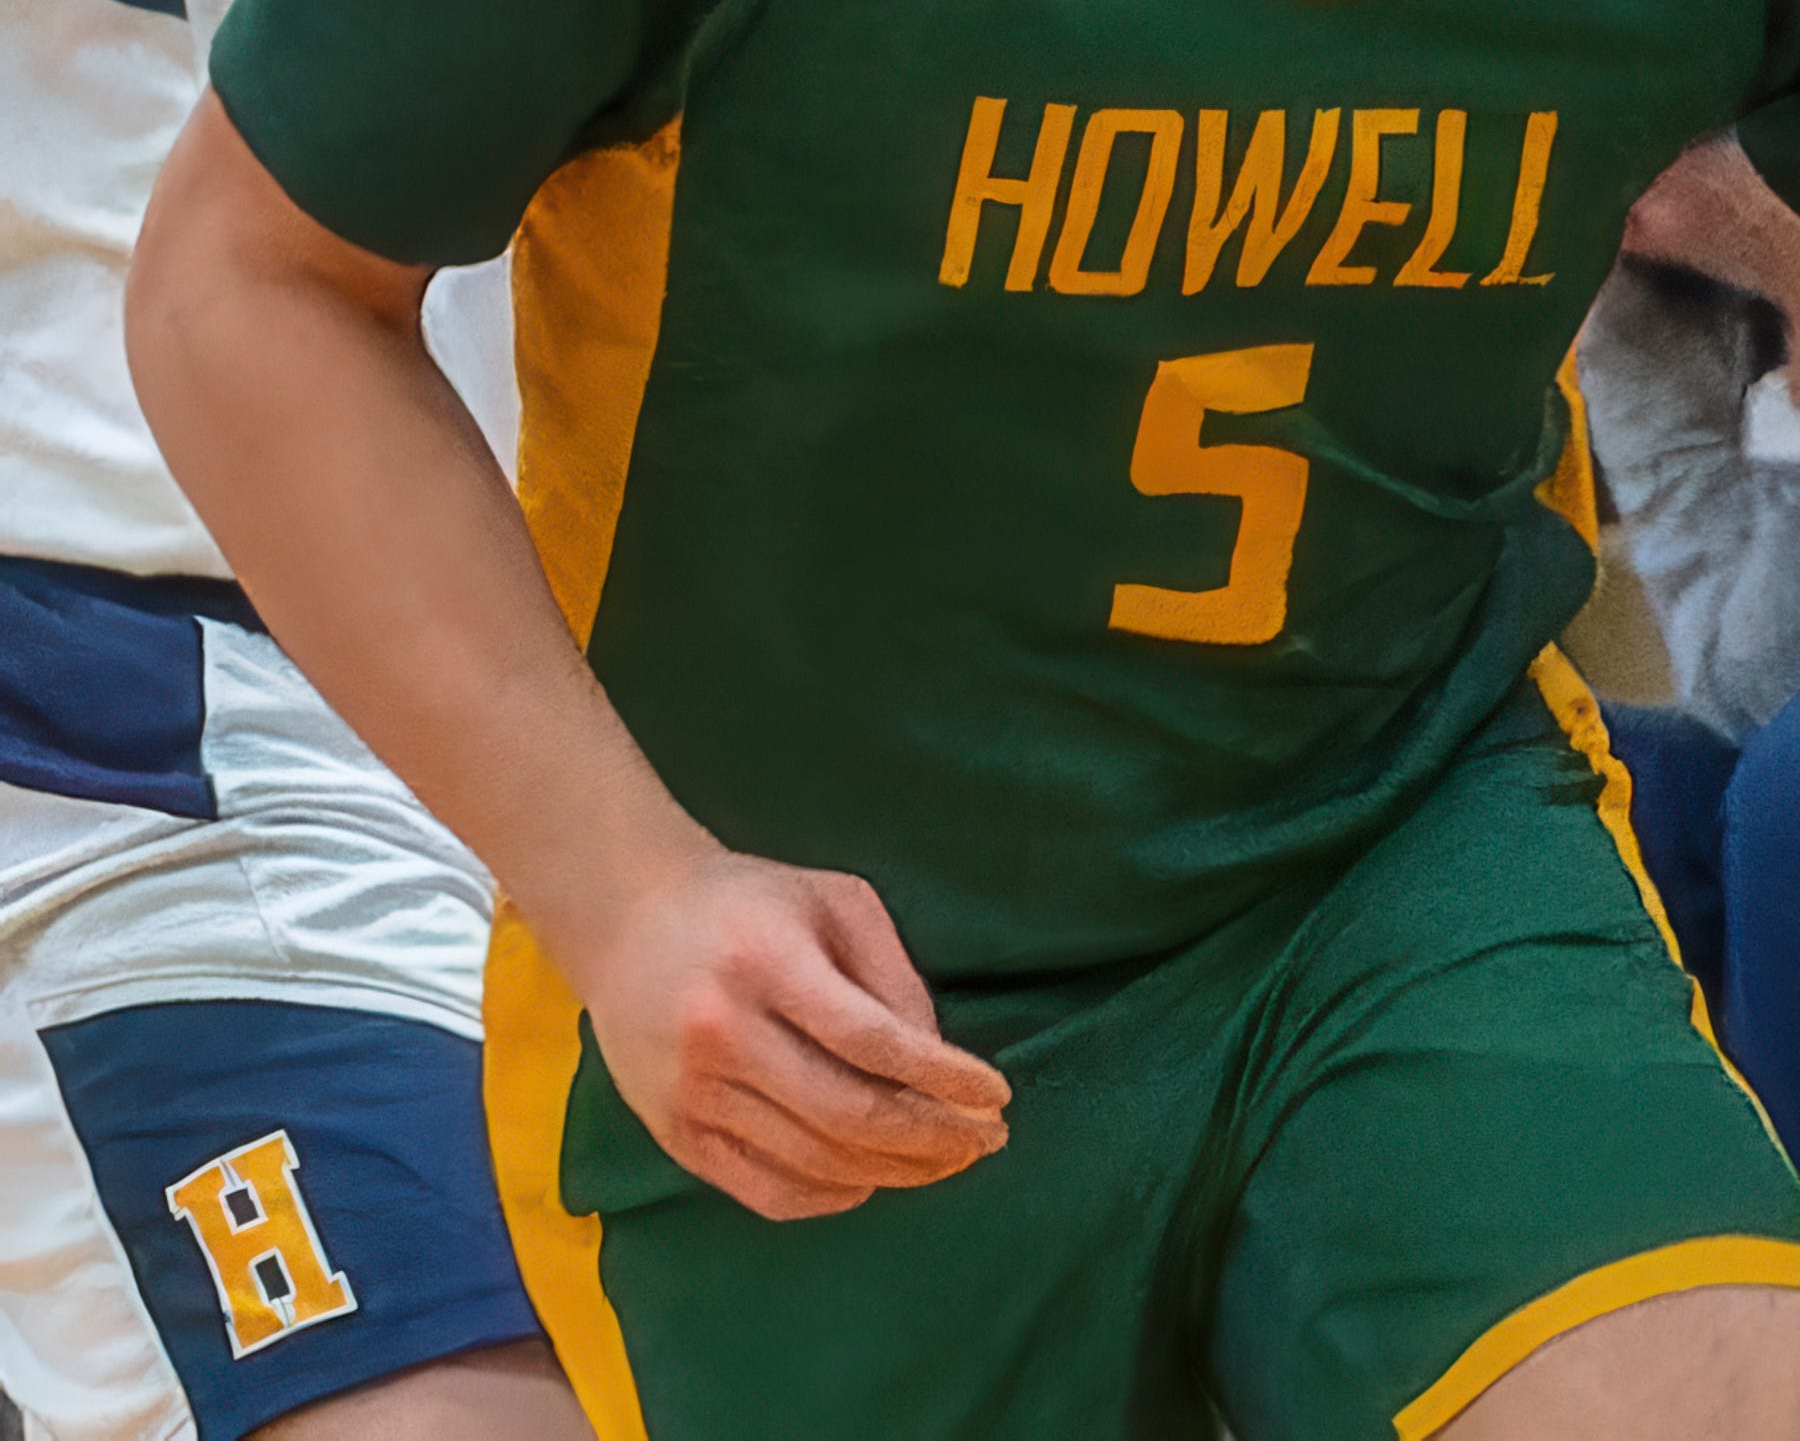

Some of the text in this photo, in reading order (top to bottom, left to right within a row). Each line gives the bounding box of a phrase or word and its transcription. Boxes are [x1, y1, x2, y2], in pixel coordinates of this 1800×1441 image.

[938, 96, 1558, 297] HOWELL
[1108, 343, 1315, 646] 5
[165, 1128, 358, 1360] H
